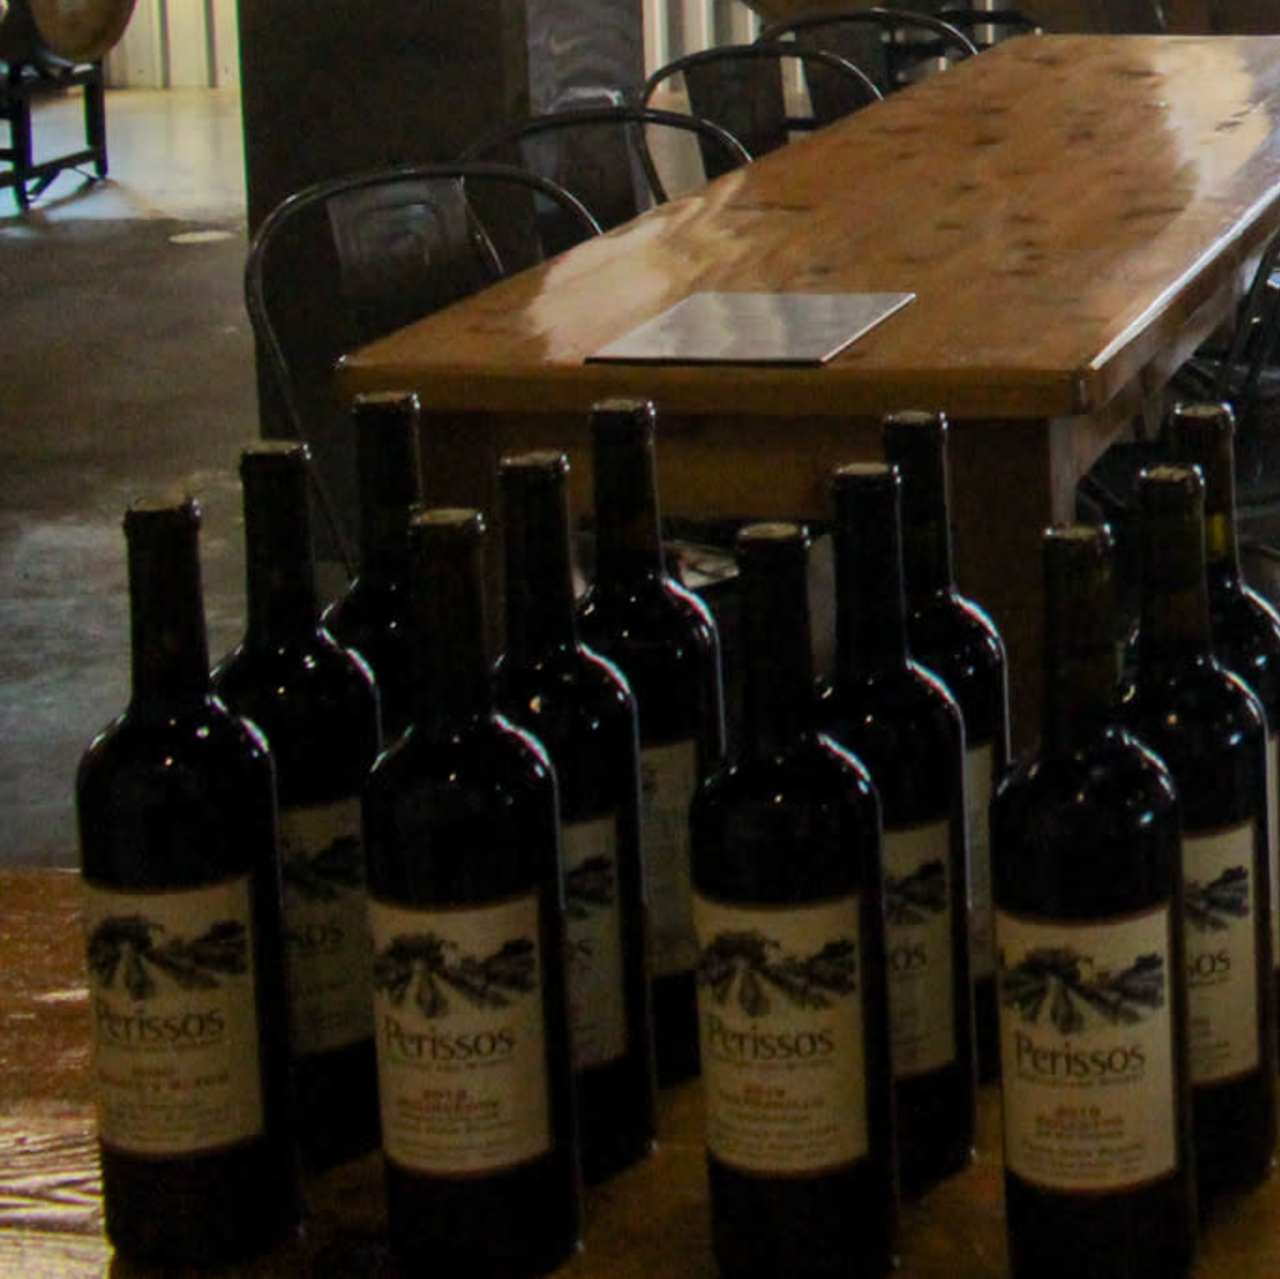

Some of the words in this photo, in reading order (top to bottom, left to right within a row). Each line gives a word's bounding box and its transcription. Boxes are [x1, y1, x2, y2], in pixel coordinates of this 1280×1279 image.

[97, 996, 225, 1040] Perissos
[384, 1016, 516, 1061] Perissos
[707, 1013, 835, 1061] Perissos
[1015, 1030, 1147, 1076] Perissos
